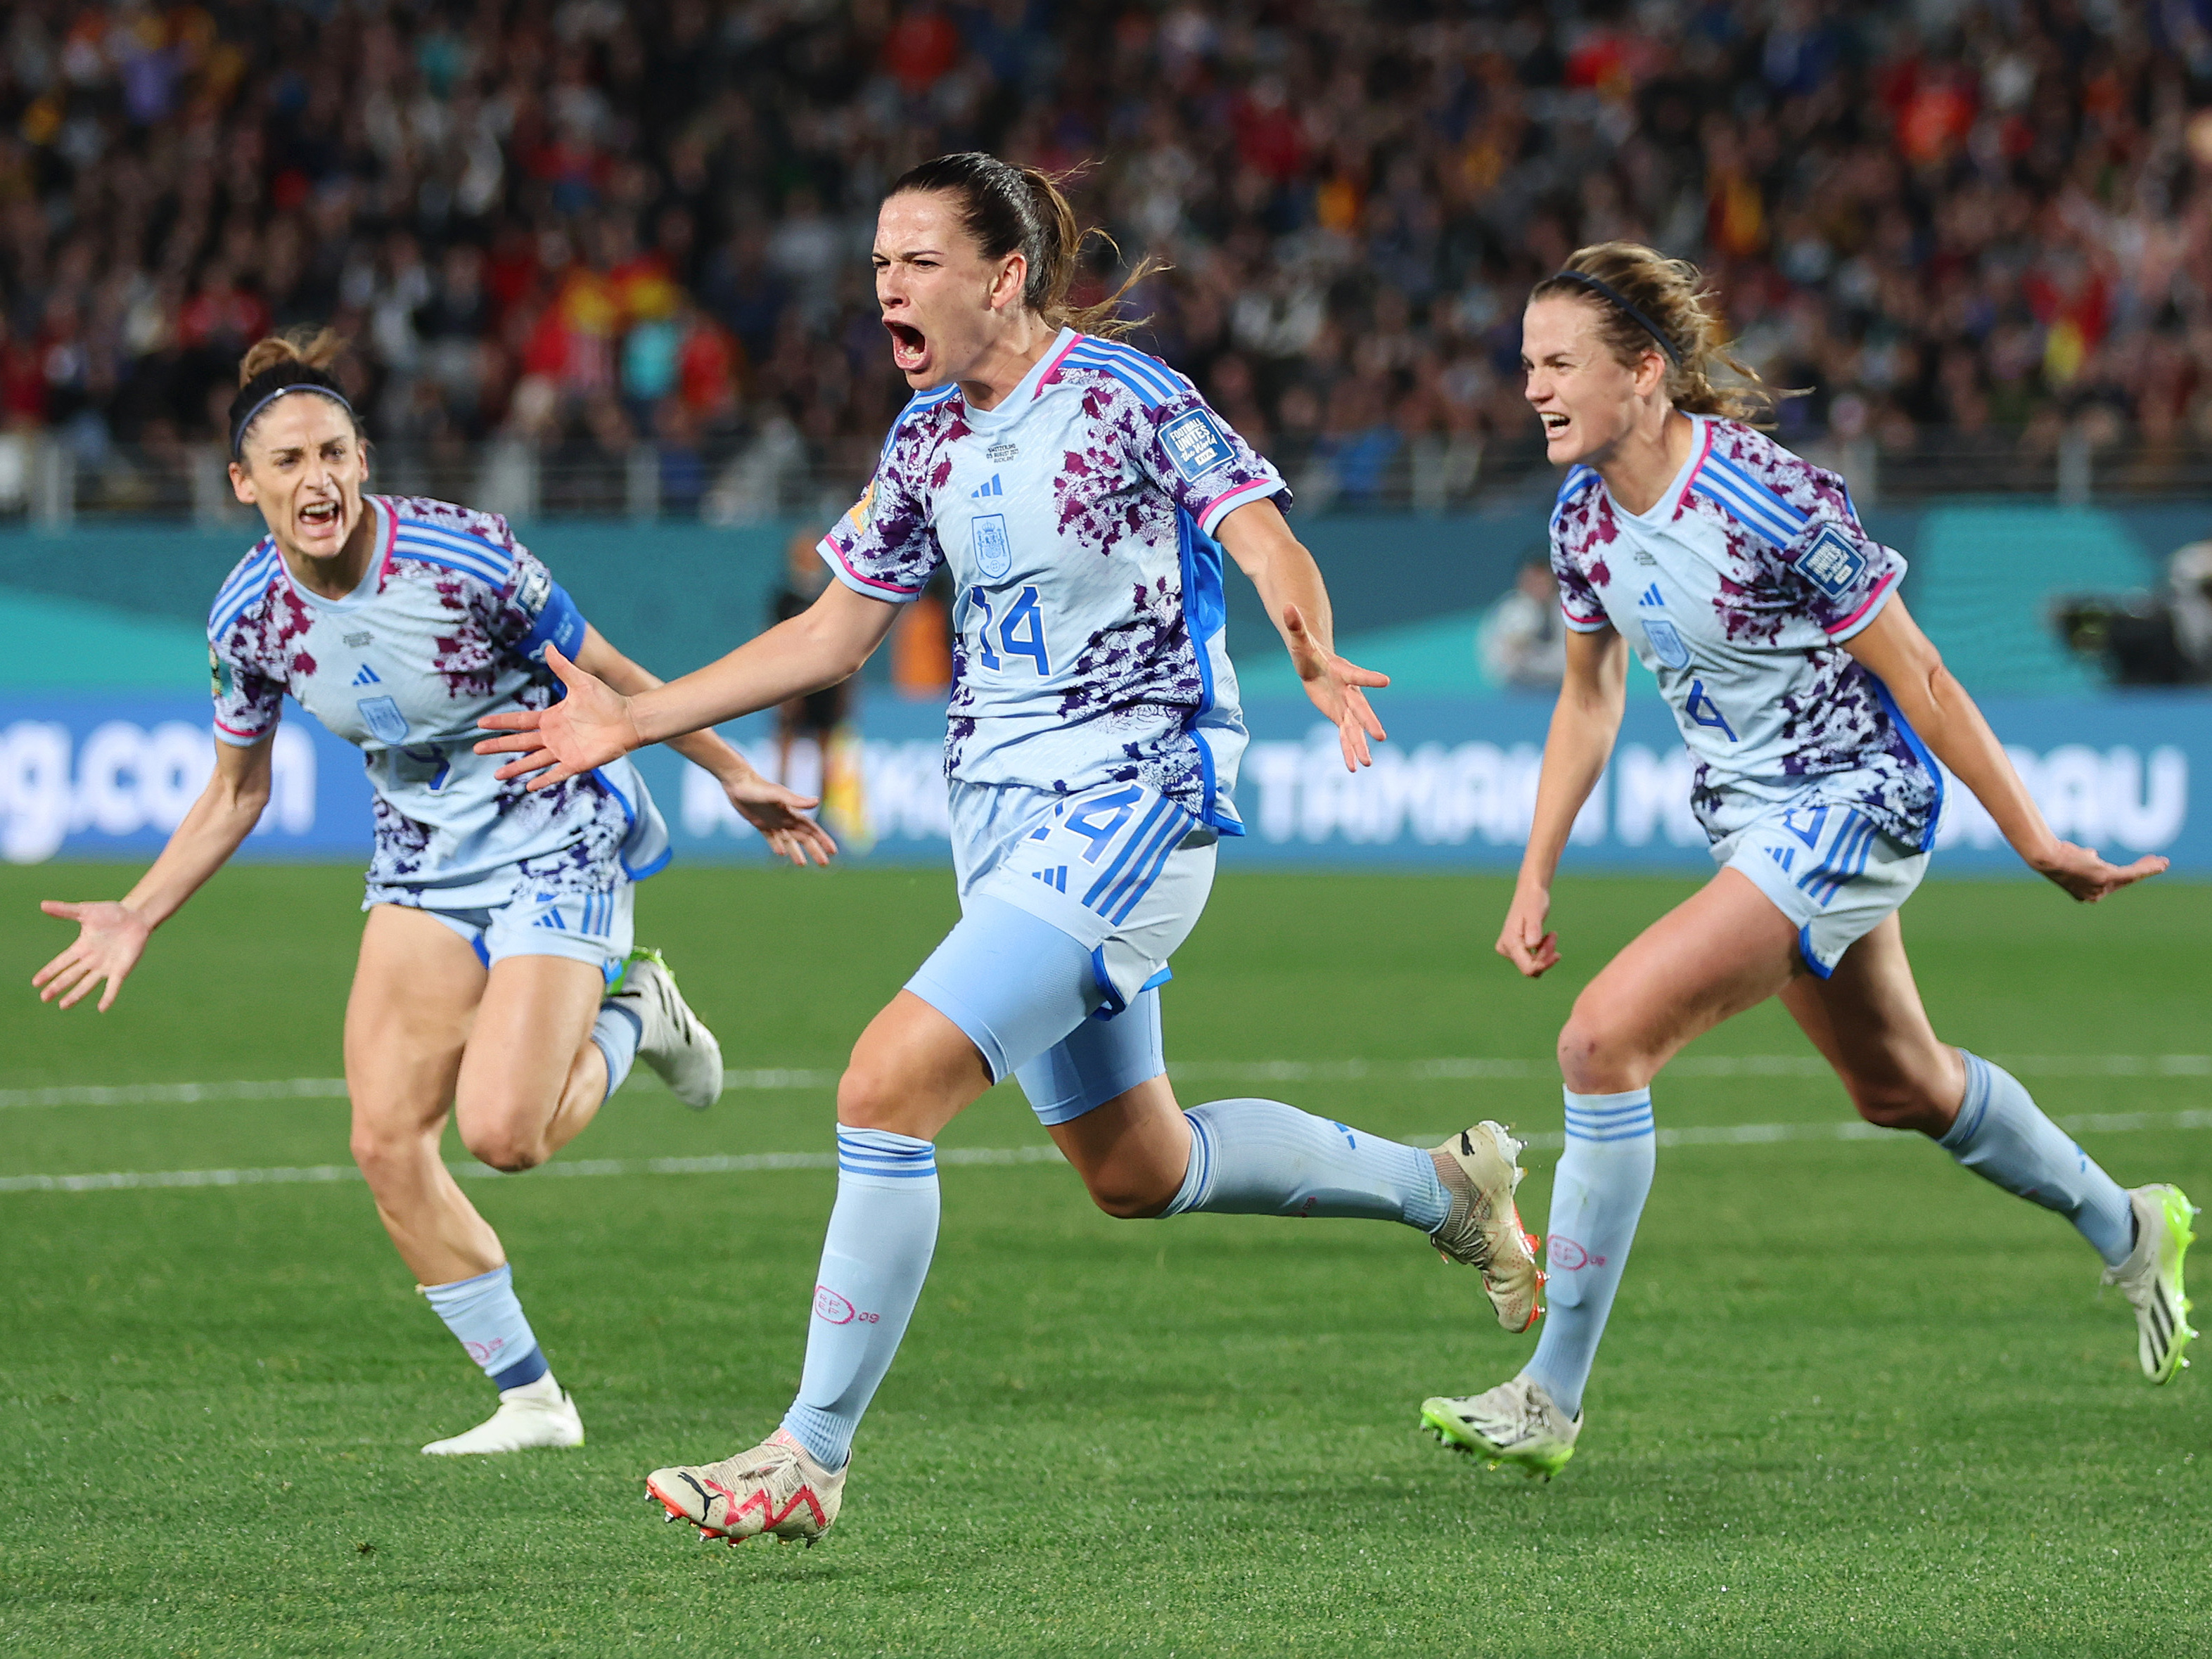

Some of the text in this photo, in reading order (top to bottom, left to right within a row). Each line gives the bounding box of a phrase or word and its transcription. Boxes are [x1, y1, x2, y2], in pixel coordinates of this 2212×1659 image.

[1169, 418, 1203, 441] FOOTBALL
[1175, 425, 1210, 452] UNITES
[1181, 434, 1217, 462] the World
[1198, 451, 1213, 463] FIFA
[969, 584, 1053, 678] 14
[1684, 677, 1739, 743] 4
[1027, 779, 1147, 867] 4
[858, 1312, 880, 1324] 09
